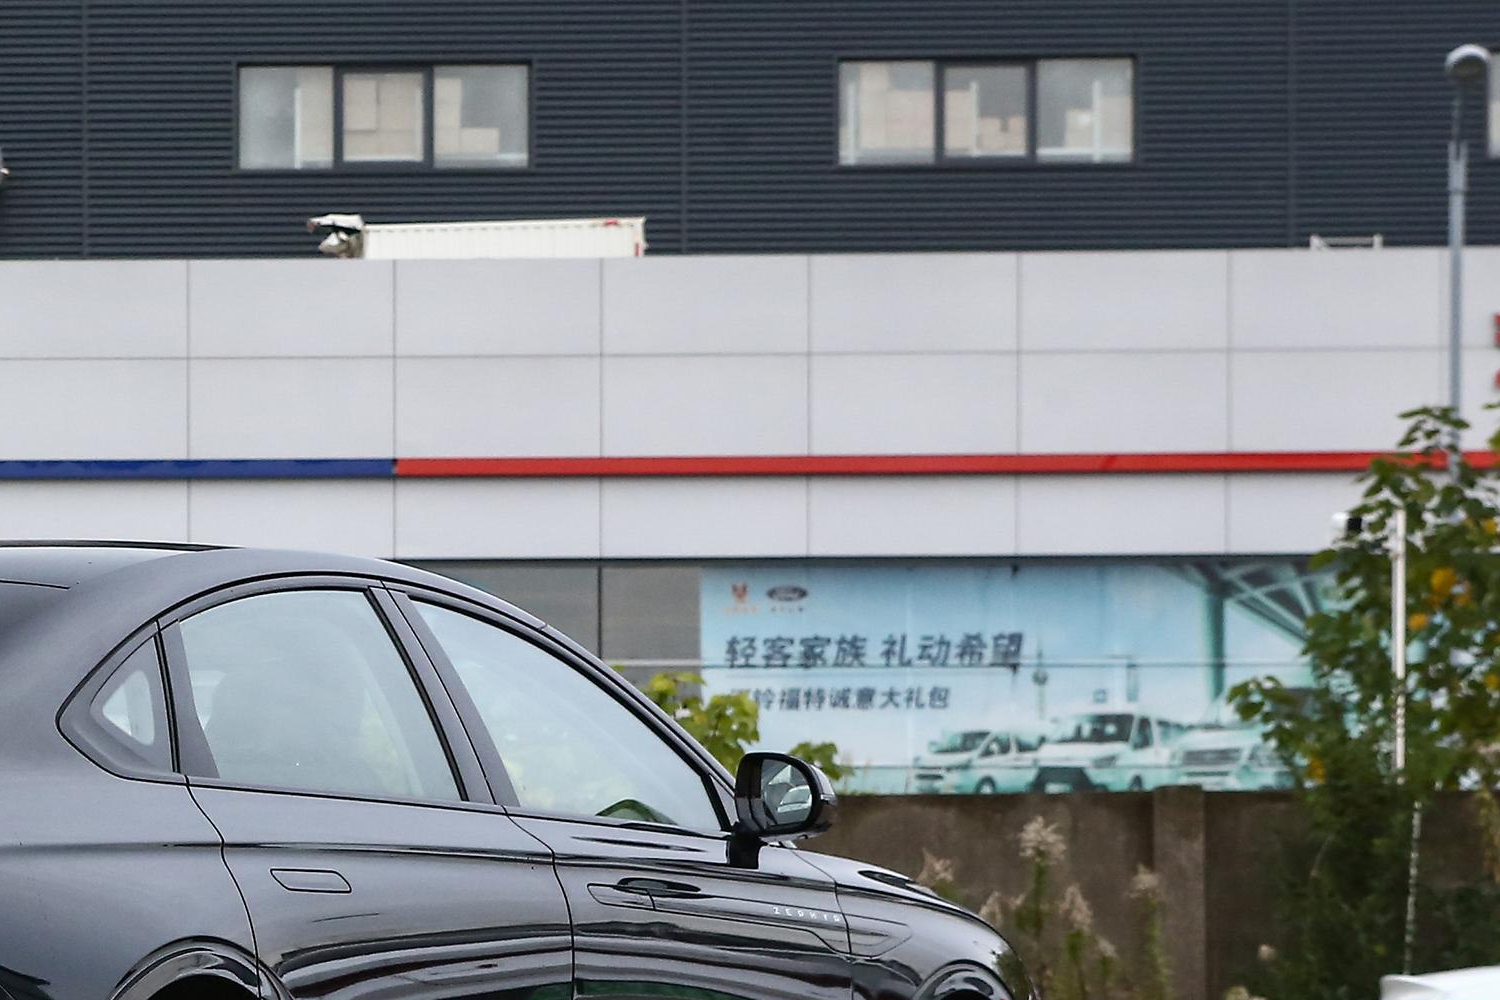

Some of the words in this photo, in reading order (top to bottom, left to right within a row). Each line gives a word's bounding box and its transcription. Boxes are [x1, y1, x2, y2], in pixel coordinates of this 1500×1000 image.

[725, 635, 867, 668] 轻客家族
[881, 632, 1023, 669] 礼动希望
[731, 687, 950, 711] 铃福特诚意大礼包
